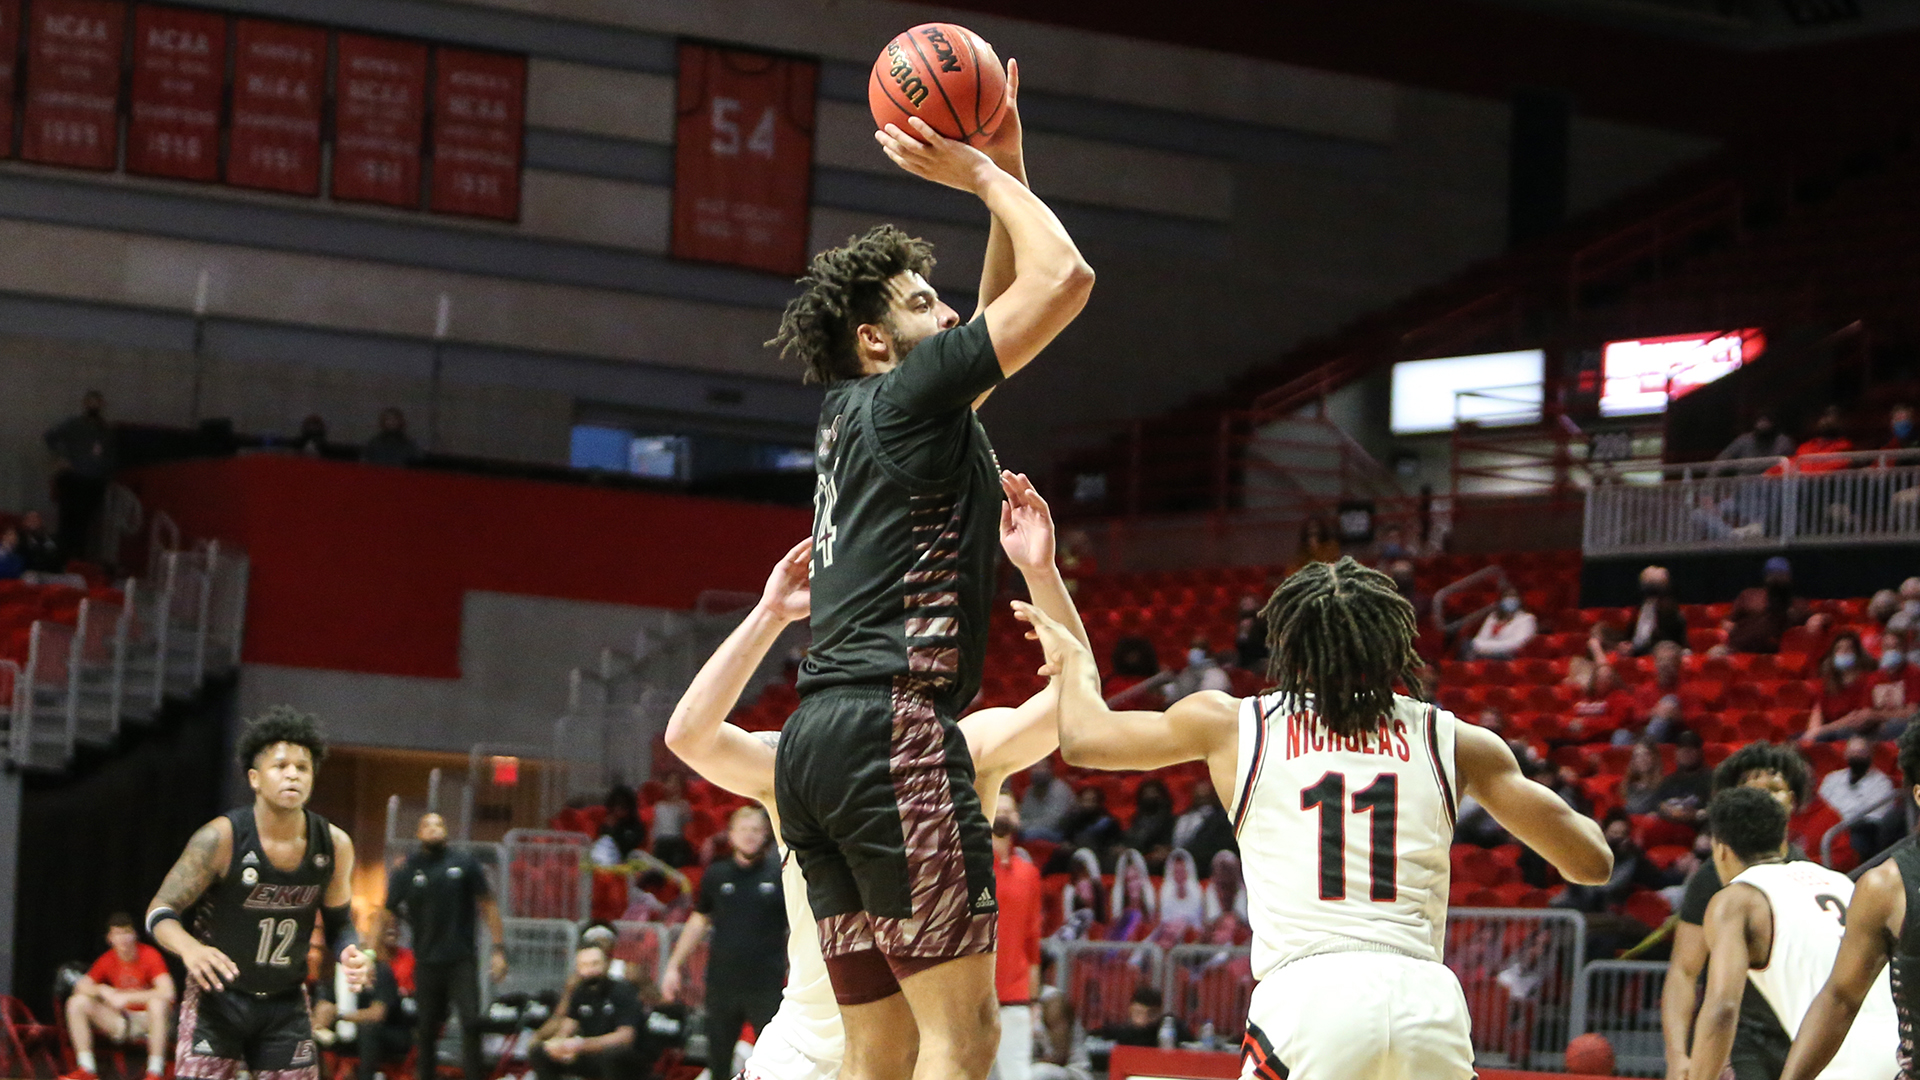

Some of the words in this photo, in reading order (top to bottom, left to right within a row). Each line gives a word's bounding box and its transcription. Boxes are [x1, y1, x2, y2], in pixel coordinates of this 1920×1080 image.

[921, 27, 961, 73] NCAA
[711, 97, 776, 160] 54
[1300, 770, 1398, 903] 11
[246, 883, 320, 909] EKU
[255, 917, 298, 966] 12
